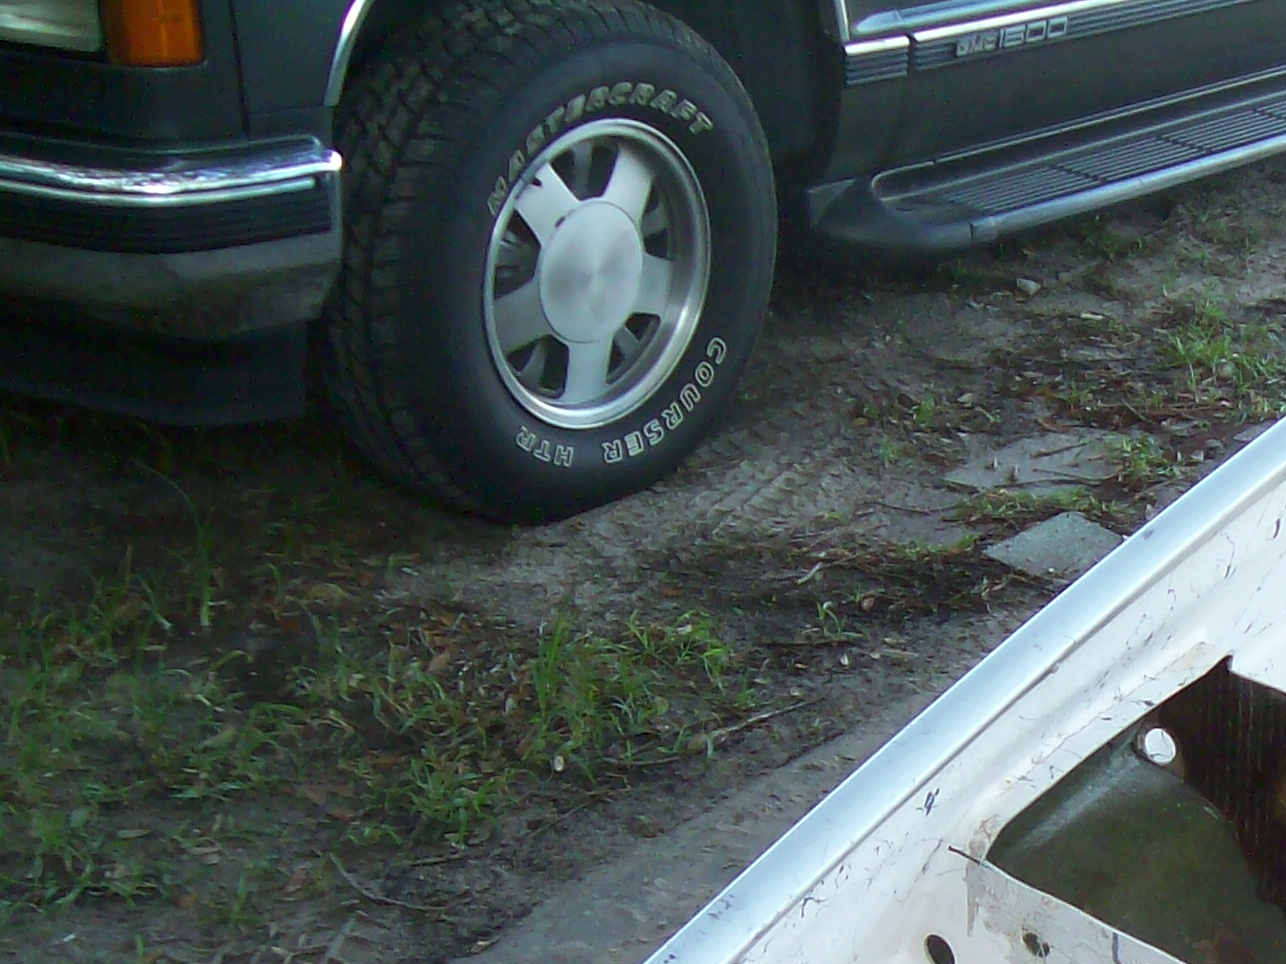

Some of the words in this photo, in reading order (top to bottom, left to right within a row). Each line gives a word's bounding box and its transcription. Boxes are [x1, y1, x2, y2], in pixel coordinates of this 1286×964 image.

[1000, 16, 1067, 49] 1500
[601, 337, 727, 464] COURSER
[514, 425, 574, 467] HTR
